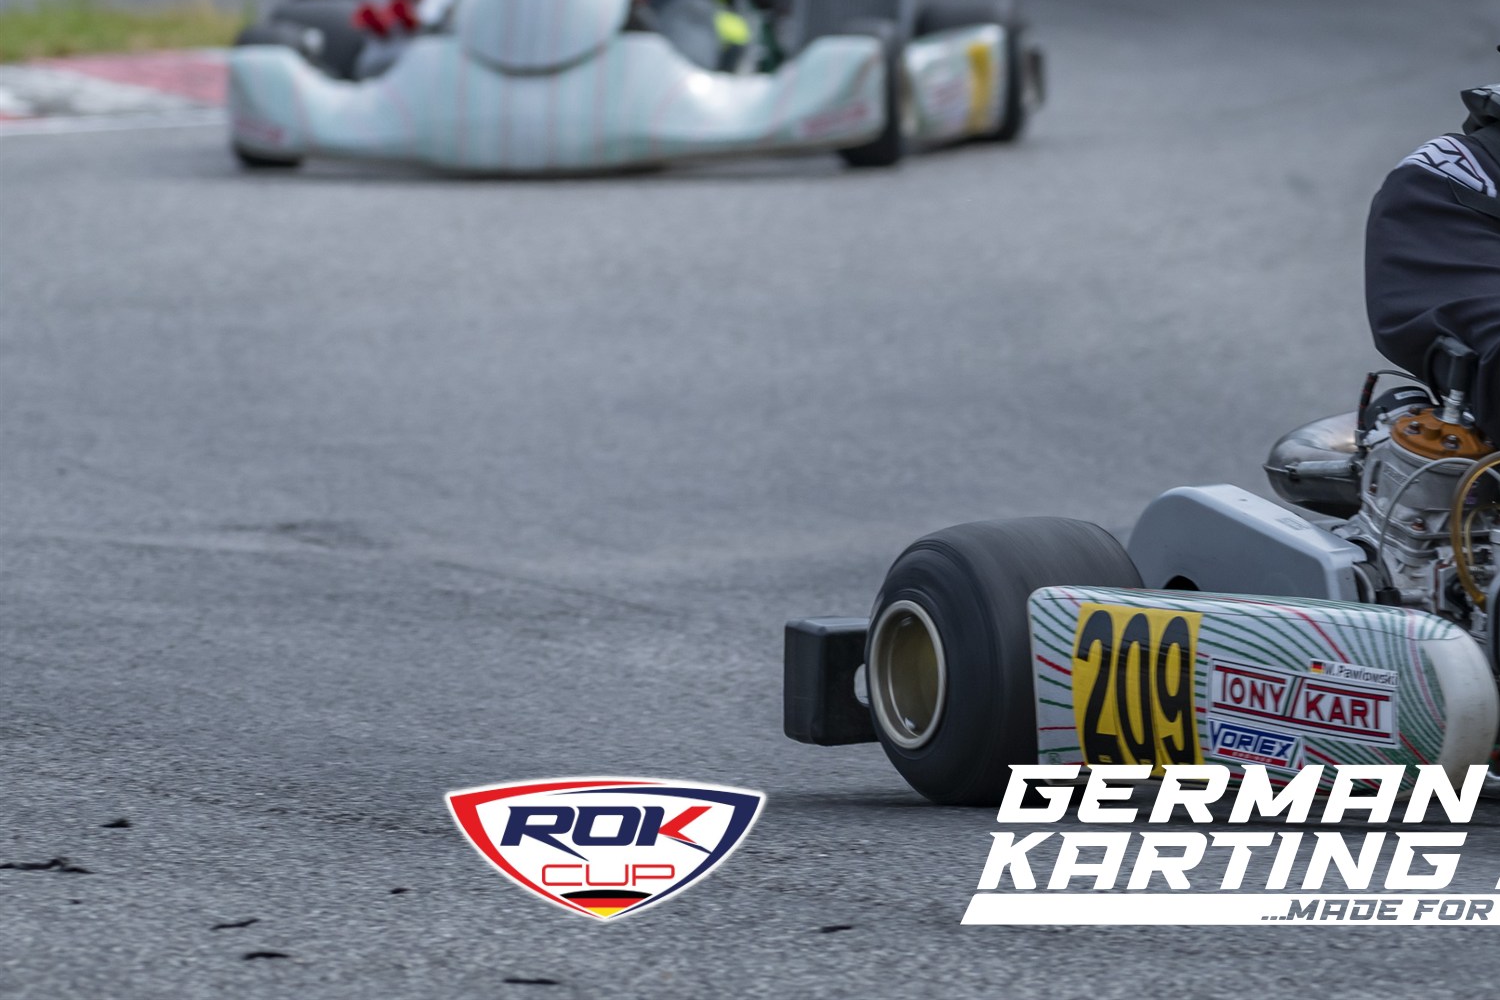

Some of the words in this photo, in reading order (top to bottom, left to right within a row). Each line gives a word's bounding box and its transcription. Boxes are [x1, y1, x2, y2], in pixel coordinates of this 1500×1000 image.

[1077, 609, 1195, 773] 209
[1212, 665, 1287, 713] TONY
[1304, 683, 1391, 730] KART
[1209, 720, 1296, 759] VORTEX
